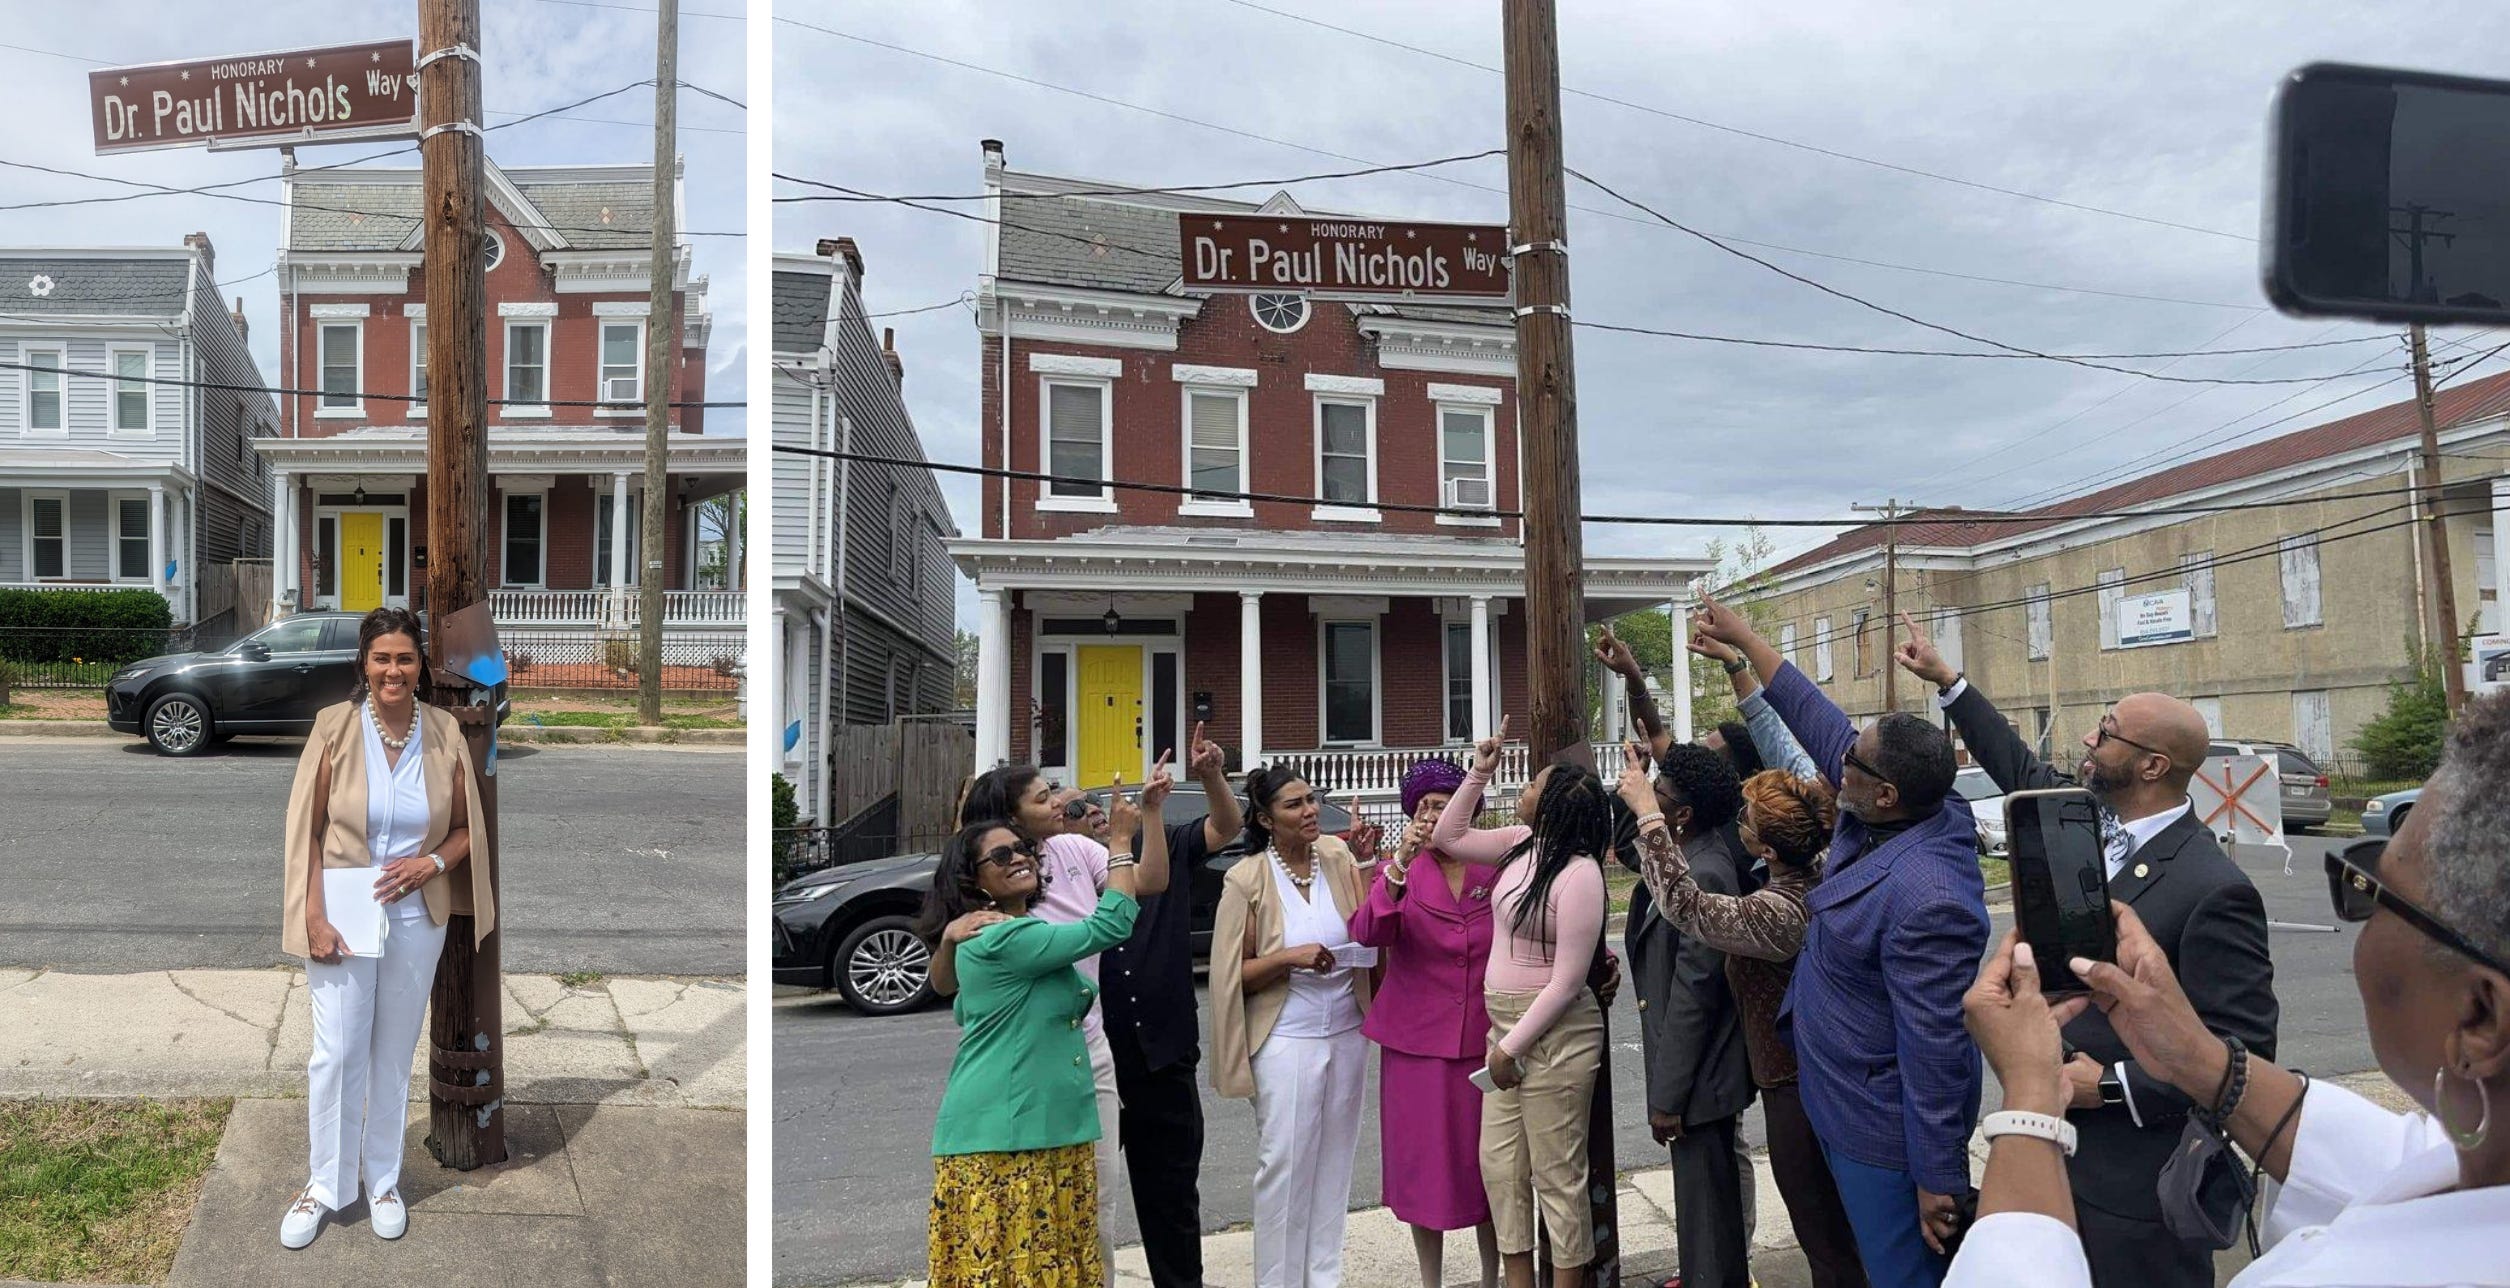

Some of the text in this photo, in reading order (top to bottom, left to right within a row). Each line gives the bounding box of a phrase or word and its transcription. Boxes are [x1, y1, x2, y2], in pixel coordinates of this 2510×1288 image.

[211, 59, 285, 80] HONORARY
[104, 69, 401, 140] Dr. Paul Nichols Way
[1311, 223, 1385, 240] HONORARY
[1195, 236, 1497, 289] Dr. Paul Nichols Way
